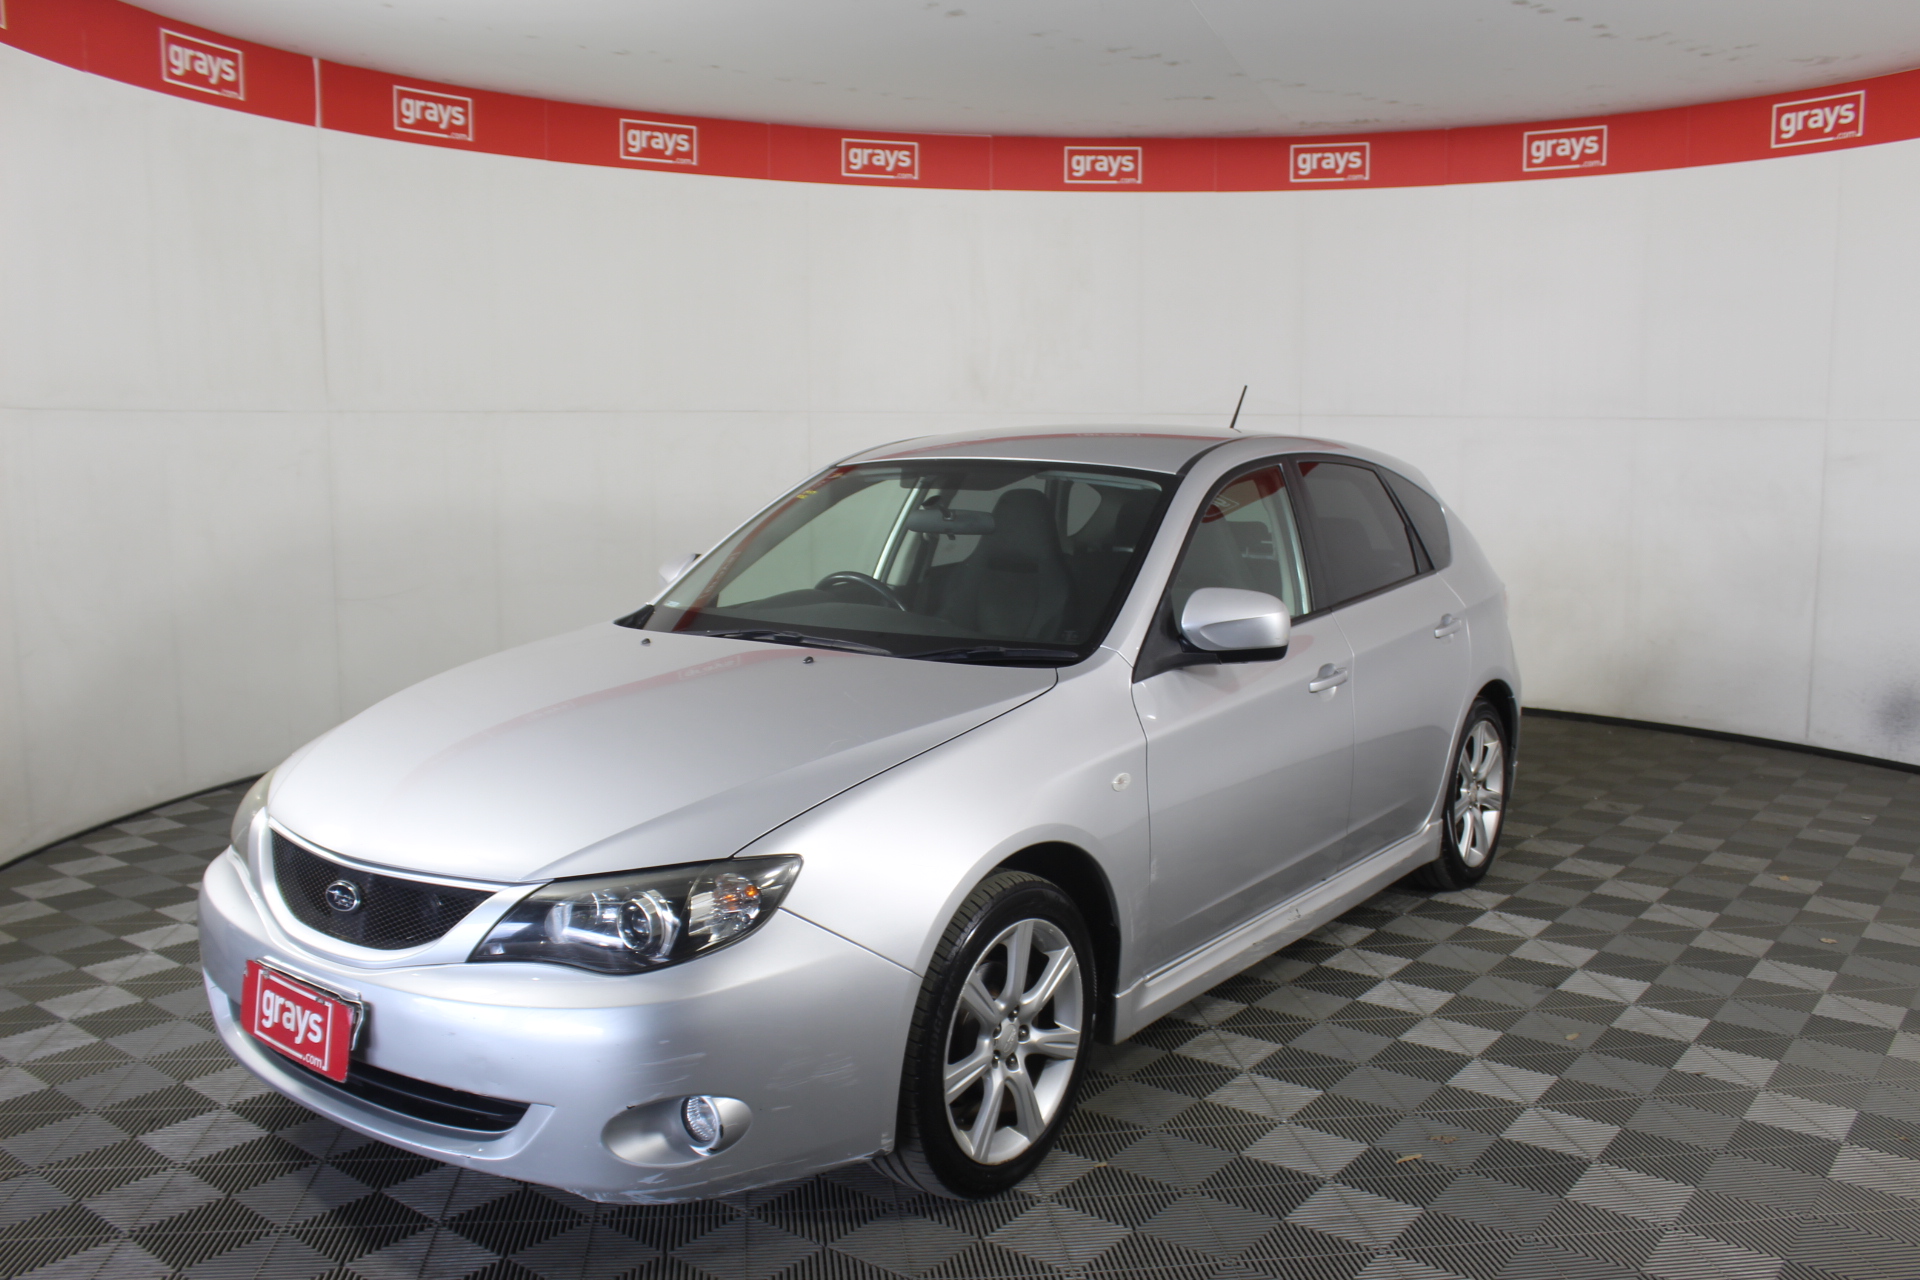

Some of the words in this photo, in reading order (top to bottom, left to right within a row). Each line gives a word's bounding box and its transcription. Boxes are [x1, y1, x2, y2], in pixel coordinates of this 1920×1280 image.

[169, 45, 236, 84] grays
[401, 98, 465, 129] grays
[1780, 104, 1855, 139] grays
[627, 129, 690, 155] grays
[1531, 136, 1599, 164] grays
[849, 148, 912, 171] grays
[1071, 155, 1134, 177] grays
[1297, 152, 1362, 175] grays
[261, 989, 323, 1044] grays
[303, 1053, 323, 1069] .com
